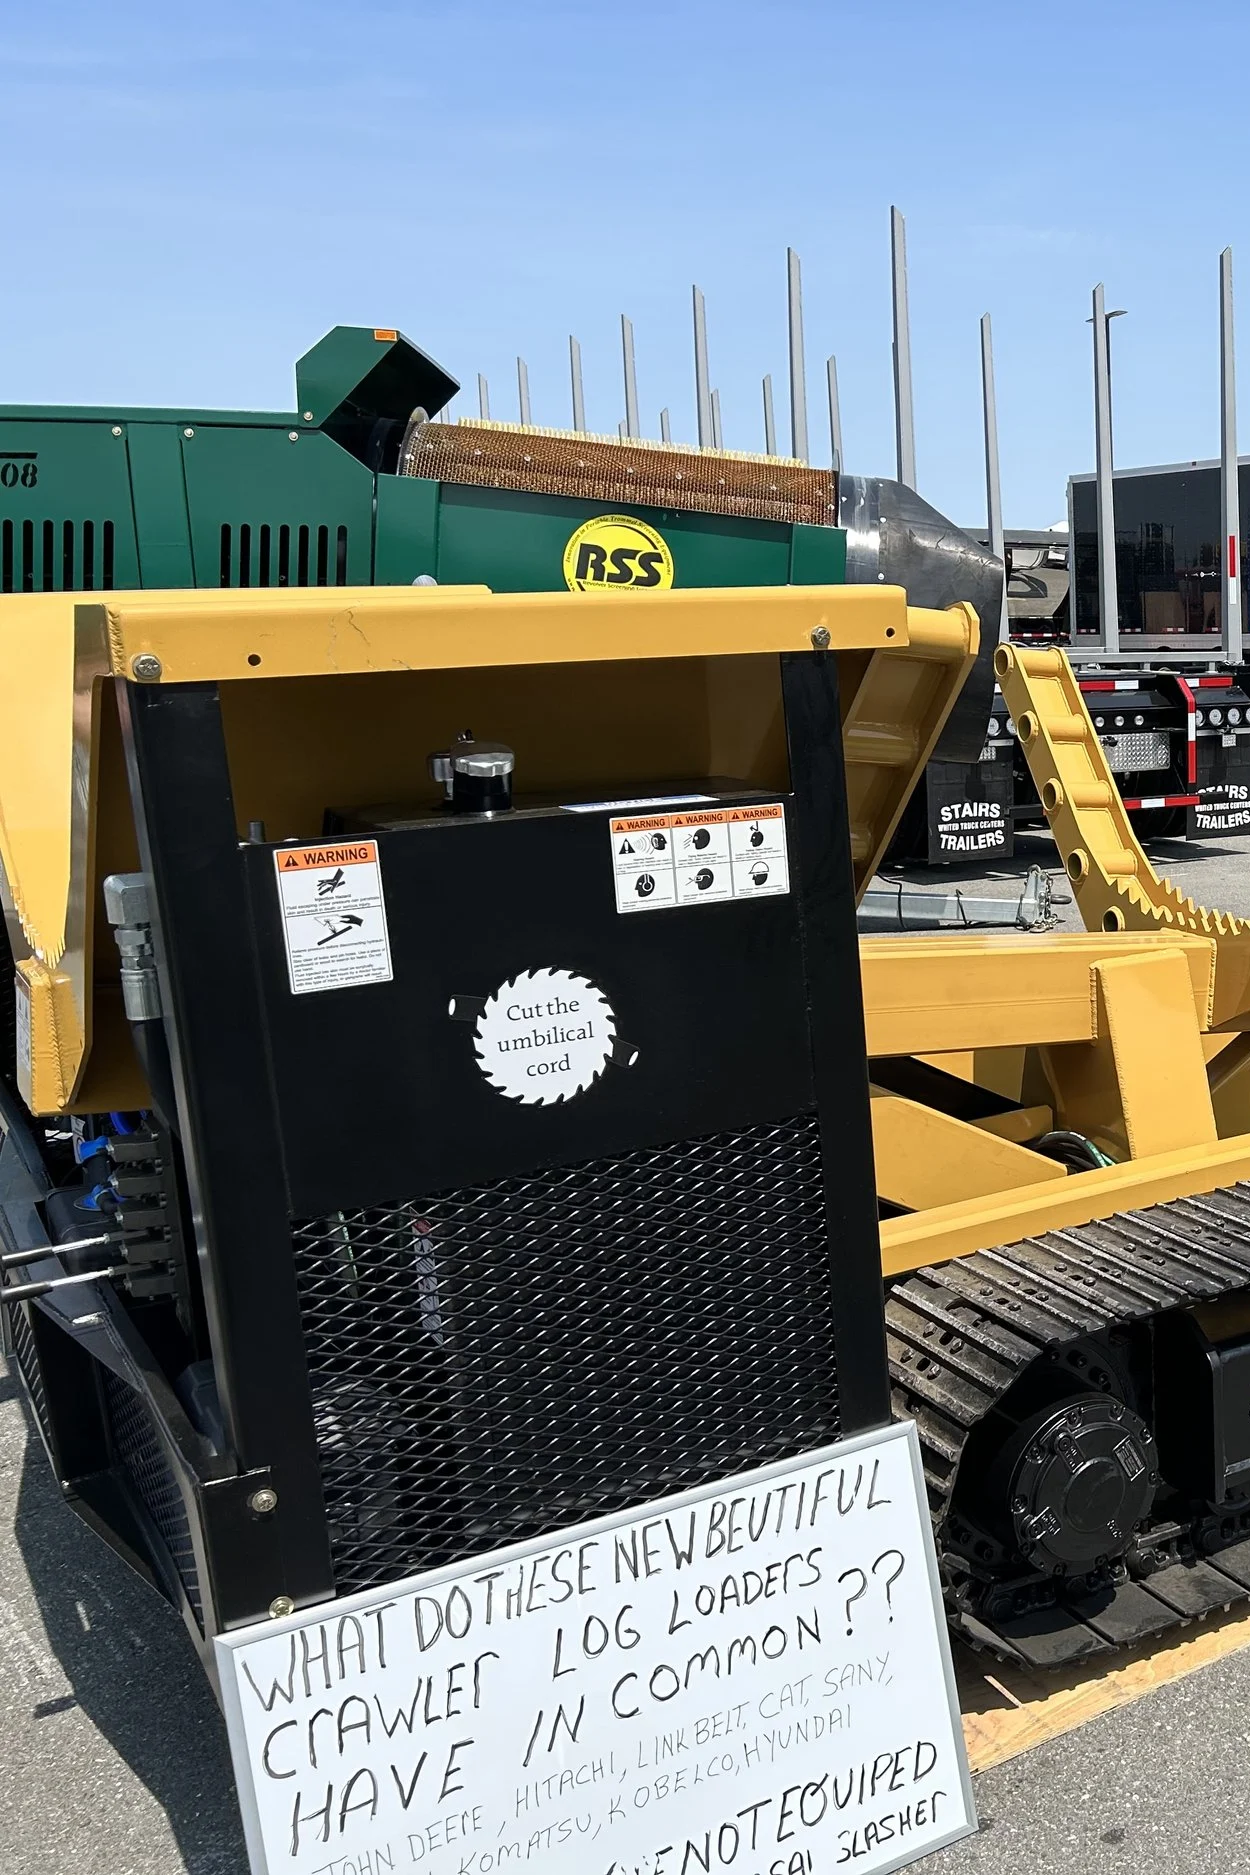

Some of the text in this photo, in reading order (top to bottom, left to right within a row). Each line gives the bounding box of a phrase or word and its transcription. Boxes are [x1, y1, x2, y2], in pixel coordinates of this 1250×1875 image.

[575, 543, 664, 587] RSS
[686, 813, 724, 824] WARNING
[742, 808, 779, 819] WARNING
[940, 802, 1001, 822] STAIRS
[1196, 810, 1250, 829] TRAILERS
[627, 819, 666, 830] WARNING
[960, 821, 979, 830] TRUCK
[940, 829, 1005, 851] TRAILERS
[304, 848, 369, 865] WARNING
[506, 996, 580, 1021] Cut the
[497, 1020, 595, 1052] umbilical
[526, 1053, 571, 1077] cord
[242, 1602, 398, 1712] WHAT
[614, 1511, 696, 1584] NEW
[705, 1459, 892, 1558] BEUTIFUL
[552, 1603, 641, 1682] LOG
[637, 1727, 689, 1770] LINK
[288, 1736, 475, 1857] HAVE
[522, 1693, 585, 1767] IN
[776, 1741, 938, 1843] EQUIPED
